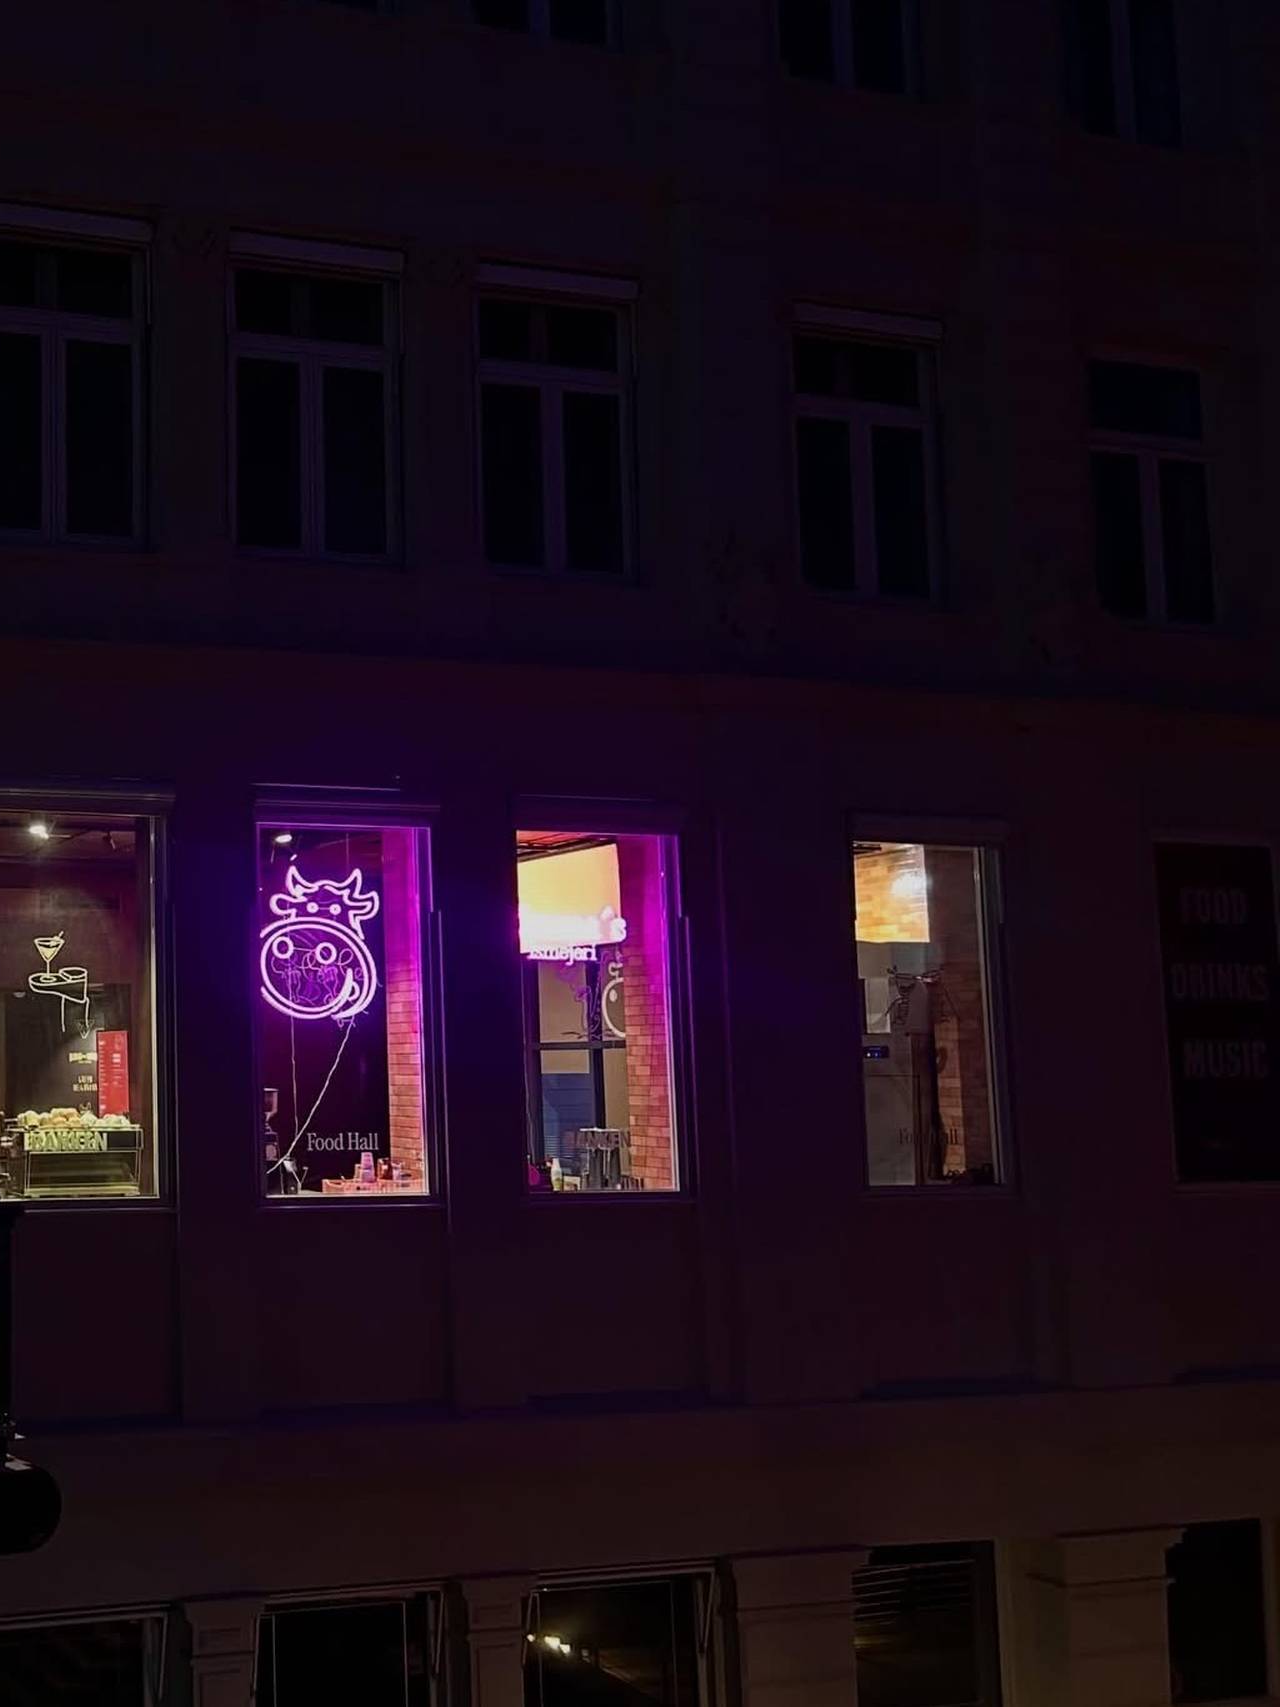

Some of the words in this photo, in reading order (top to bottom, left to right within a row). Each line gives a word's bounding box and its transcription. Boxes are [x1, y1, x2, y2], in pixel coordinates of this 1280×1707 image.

[1179, 887, 1248, 926] FOOD
[1170, 961, 1269, 1002] DRINKS
[1183, 1037, 1269, 1079] MUSIC
[307, 1132, 344, 1151] Food
[347, 1132, 380, 1151] Hall
